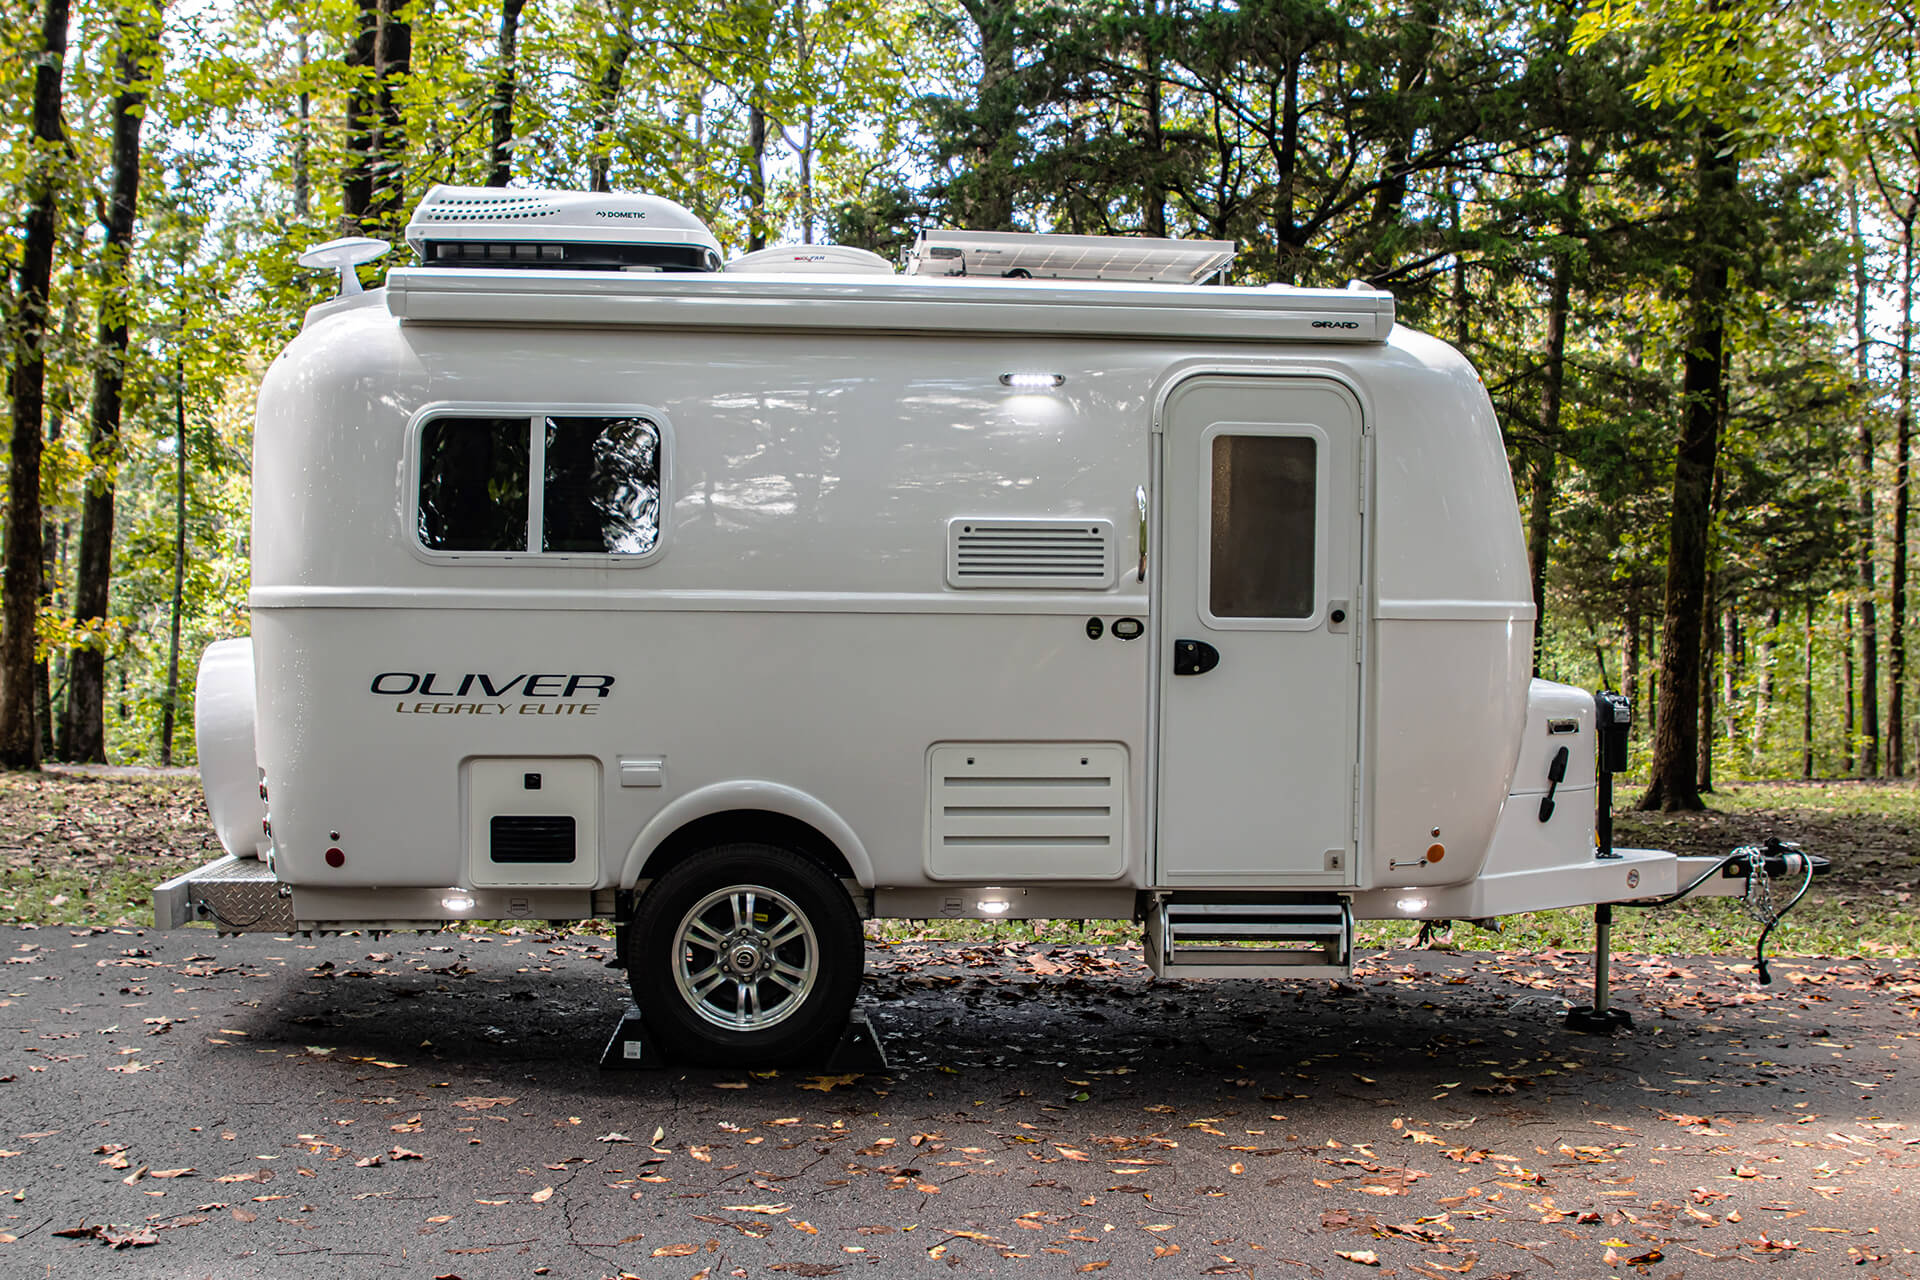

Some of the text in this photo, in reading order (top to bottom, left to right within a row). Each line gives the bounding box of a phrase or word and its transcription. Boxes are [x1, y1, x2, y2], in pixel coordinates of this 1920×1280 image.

[607, 210, 646, 219] DOMETIC
[1311, 320, 1360, 329] GIRARD
[370, 672, 616, 698] OLIVER
[396, 701, 601, 715] LEGACY ELITE
